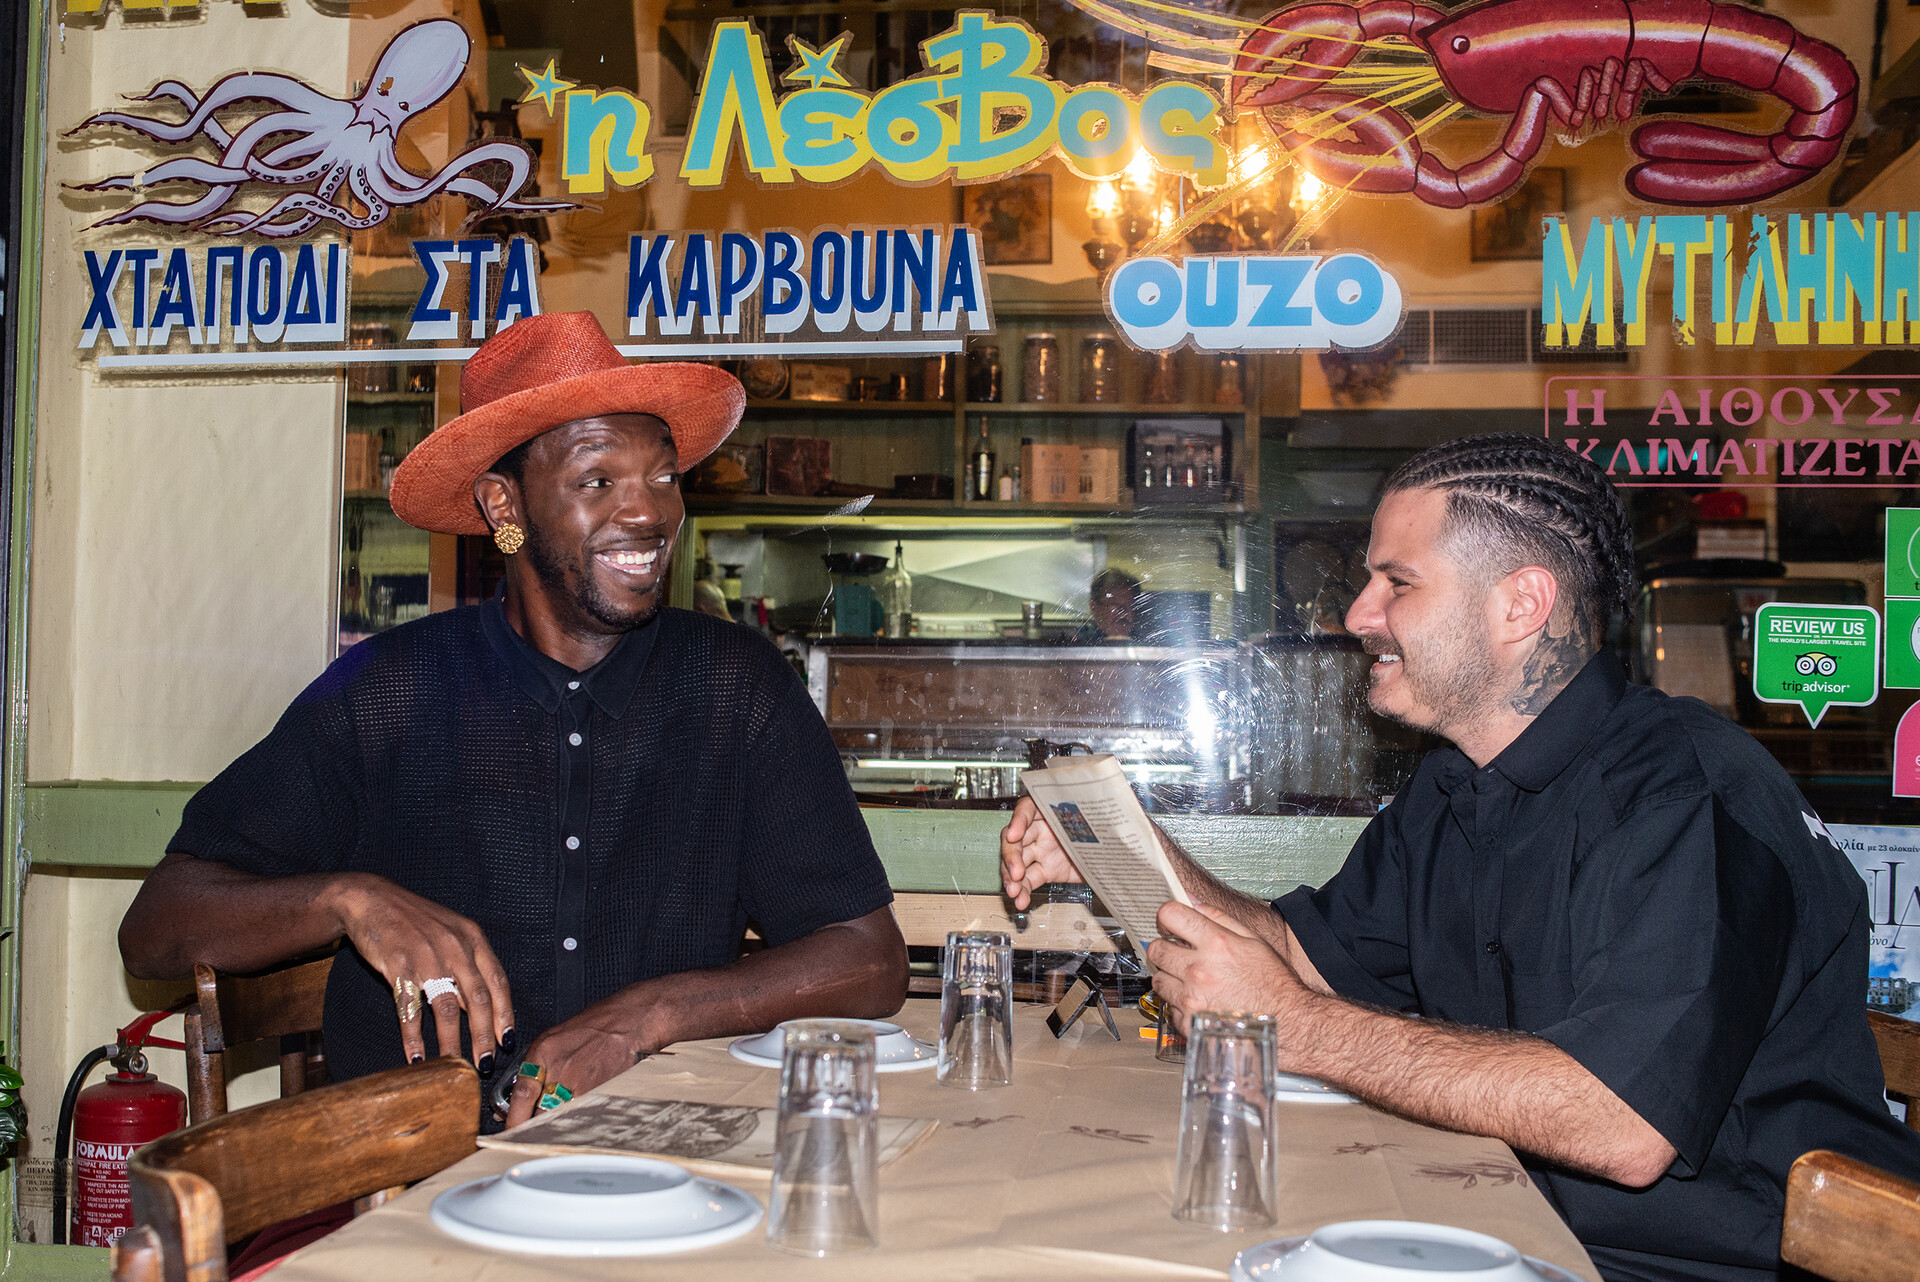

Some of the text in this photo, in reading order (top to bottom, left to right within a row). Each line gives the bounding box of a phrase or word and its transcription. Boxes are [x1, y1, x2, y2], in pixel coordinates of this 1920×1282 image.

[78, 244, 346, 348] ΧΤΑΠΟΔΙ
[407, 236, 540, 341] ΣΤΑ
[1109, 255, 1402, 349] OUZO
[1563, 388, 1608, 426] Η
[1770, 619, 1865, 635] REVIEW US
[1782, 680, 1847, 694] tripadvisor
[76, 1141, 135, 1160] FORMULA
[93, 1227, 124, 1236] A B
